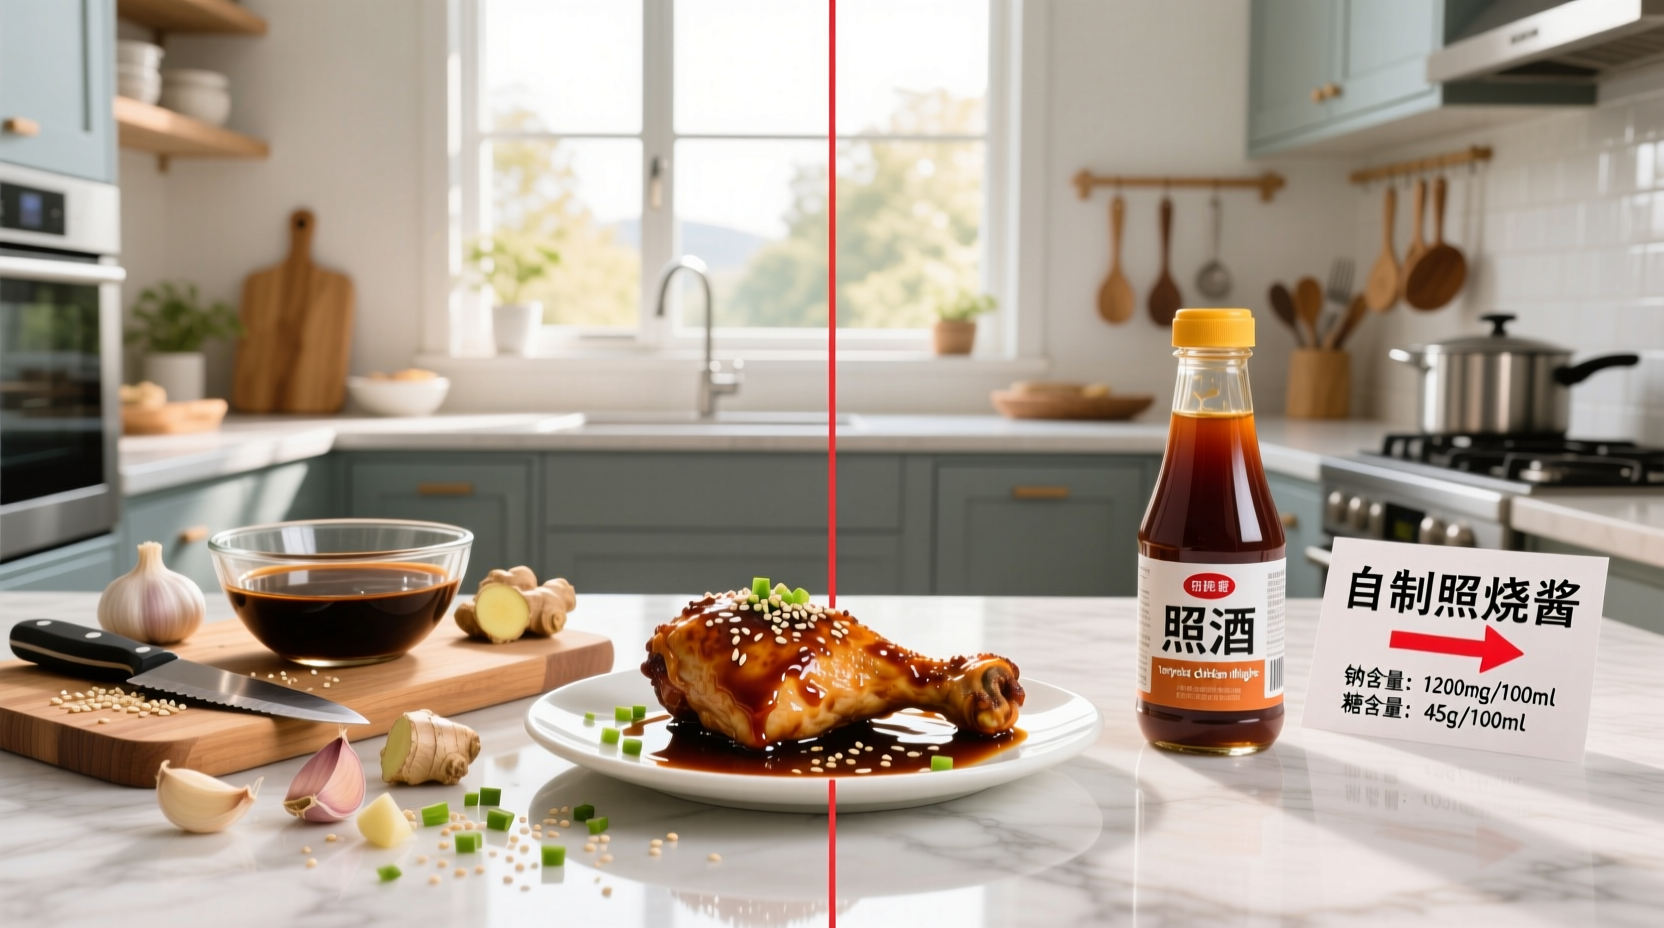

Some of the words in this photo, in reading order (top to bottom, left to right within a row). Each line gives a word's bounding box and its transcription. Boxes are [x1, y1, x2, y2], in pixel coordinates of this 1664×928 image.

[1347, 565, 1581, 628] 自制照烧酱
[1162, 605, 1255, 655] 照酒
